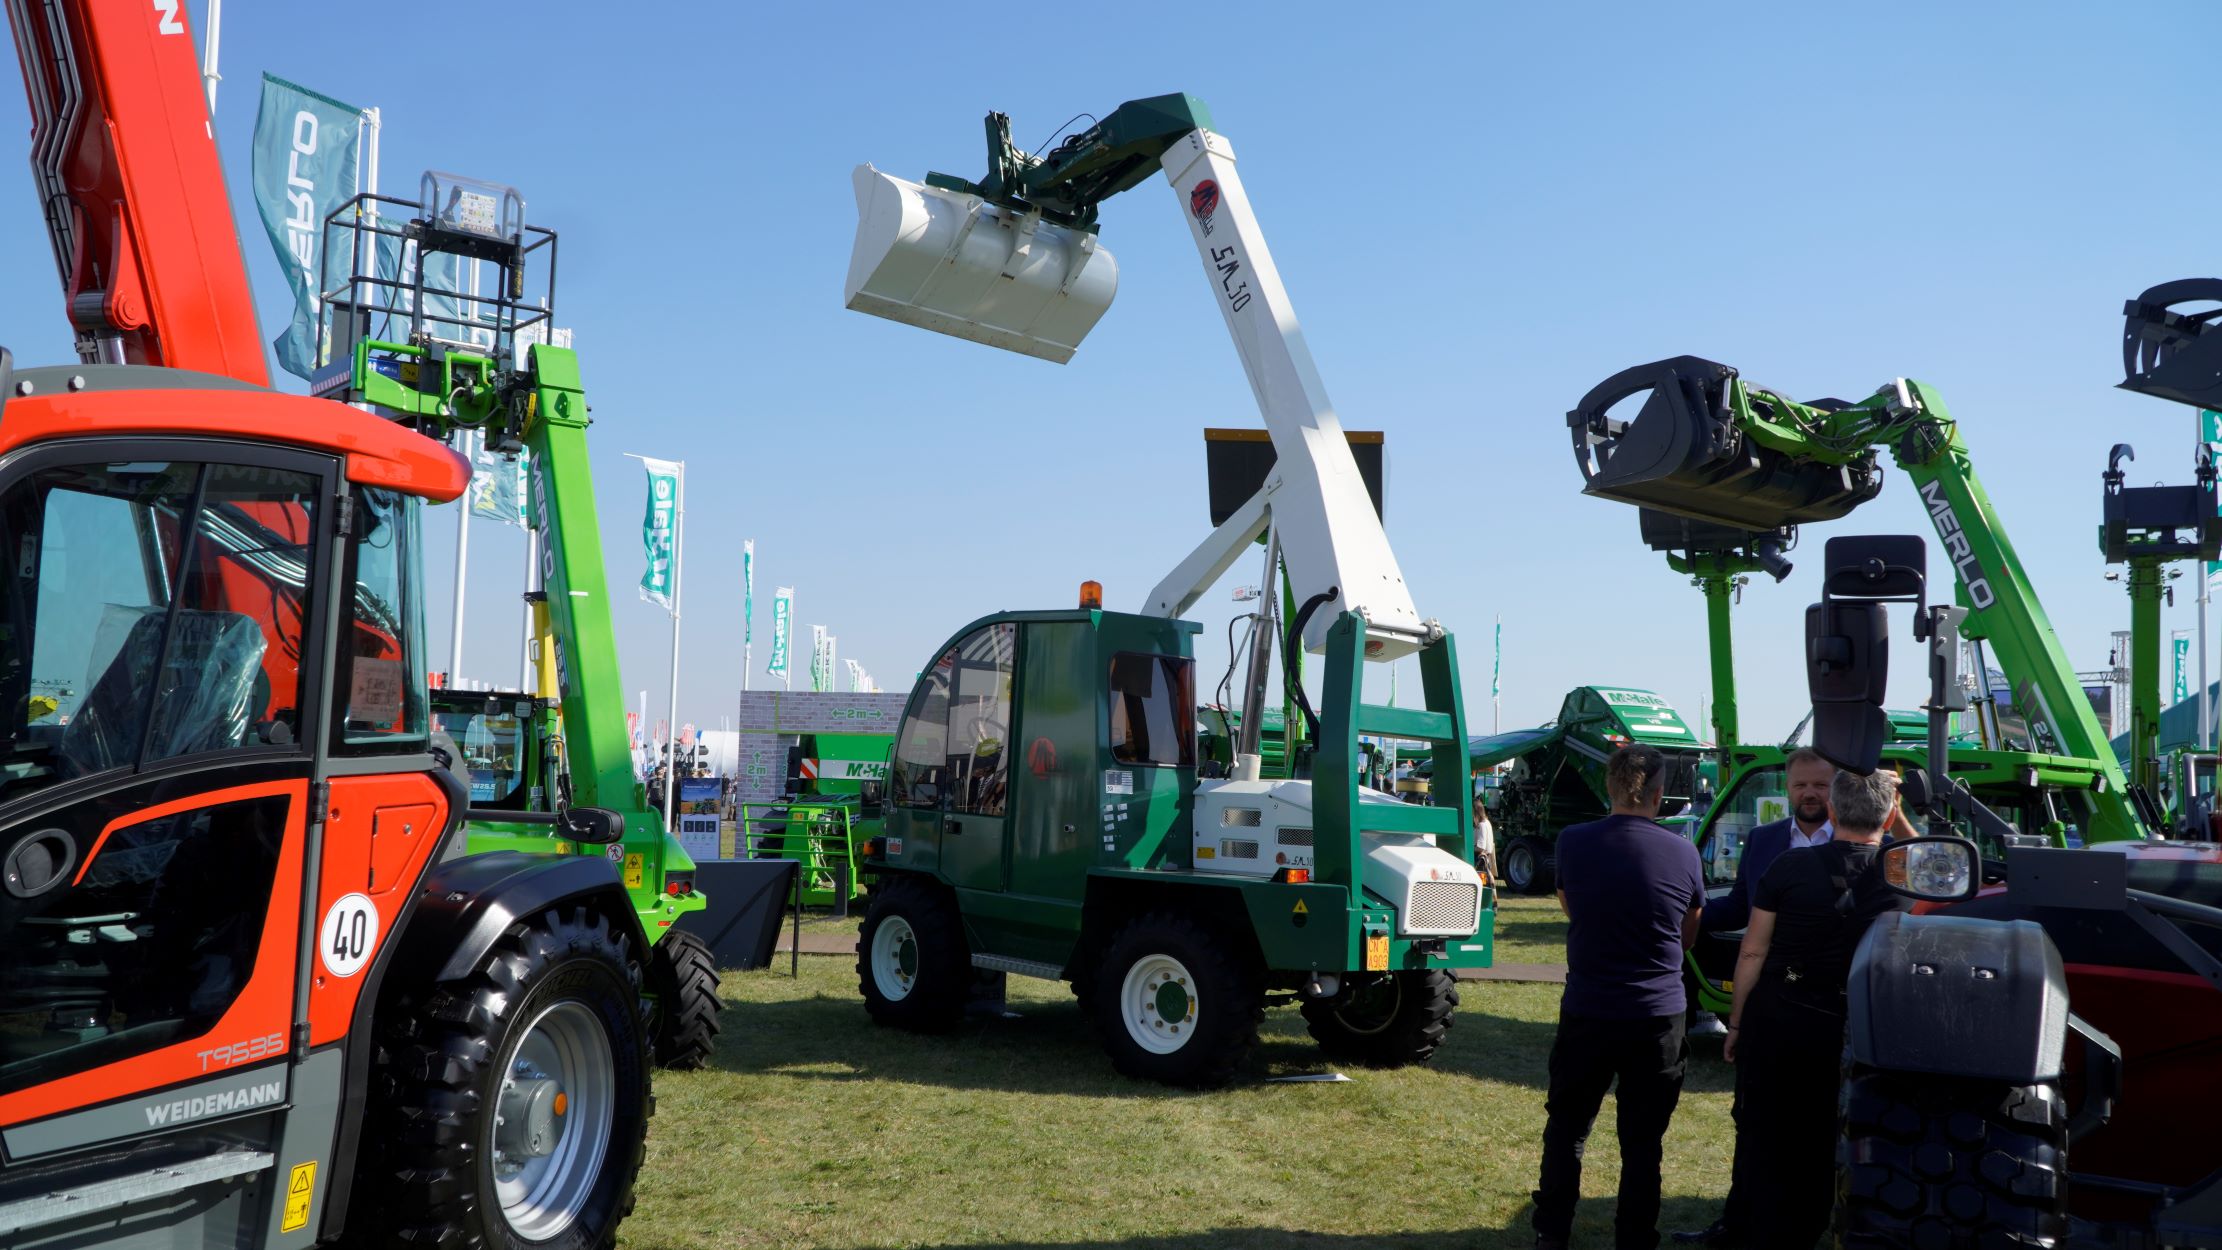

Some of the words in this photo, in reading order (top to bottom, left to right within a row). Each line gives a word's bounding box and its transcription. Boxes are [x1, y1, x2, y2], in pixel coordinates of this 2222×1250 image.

[531, 451, 554, 579] MERLO
[1921, 479, 1995, 610] MERLO
[846, 762, 889, 778] McHa
[333, 909, 367, 961] 40
[197, 1032, 284, 1072] T9535
[145, 1082, 281, 1126] WEIDEMANN
